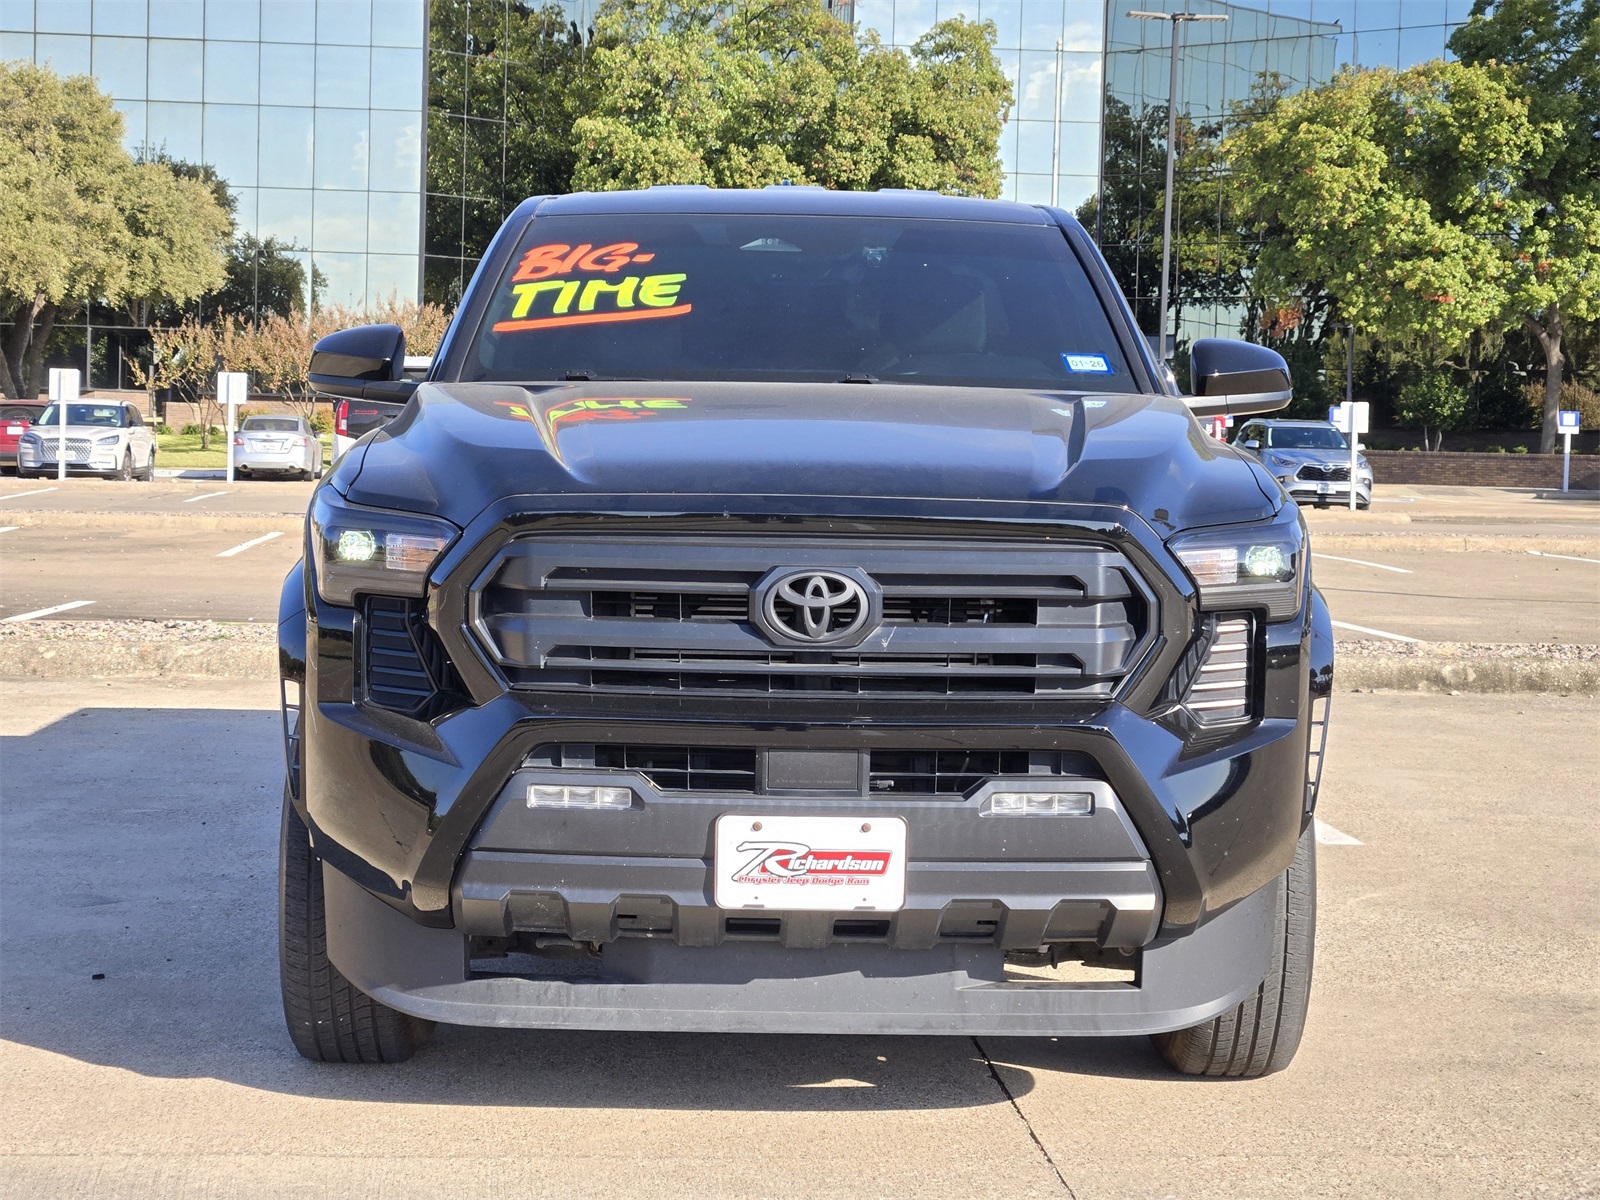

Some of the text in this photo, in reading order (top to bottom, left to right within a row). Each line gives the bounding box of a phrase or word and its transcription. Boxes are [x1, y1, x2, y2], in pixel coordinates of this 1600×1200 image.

[512, 242, 655, 281] BIG-
[512, 273, 687, 318] TIME
[731, 841, 885, 881] Richardson
[738, 874, 870, 886] Chrysler Jeep Dodge Ram
